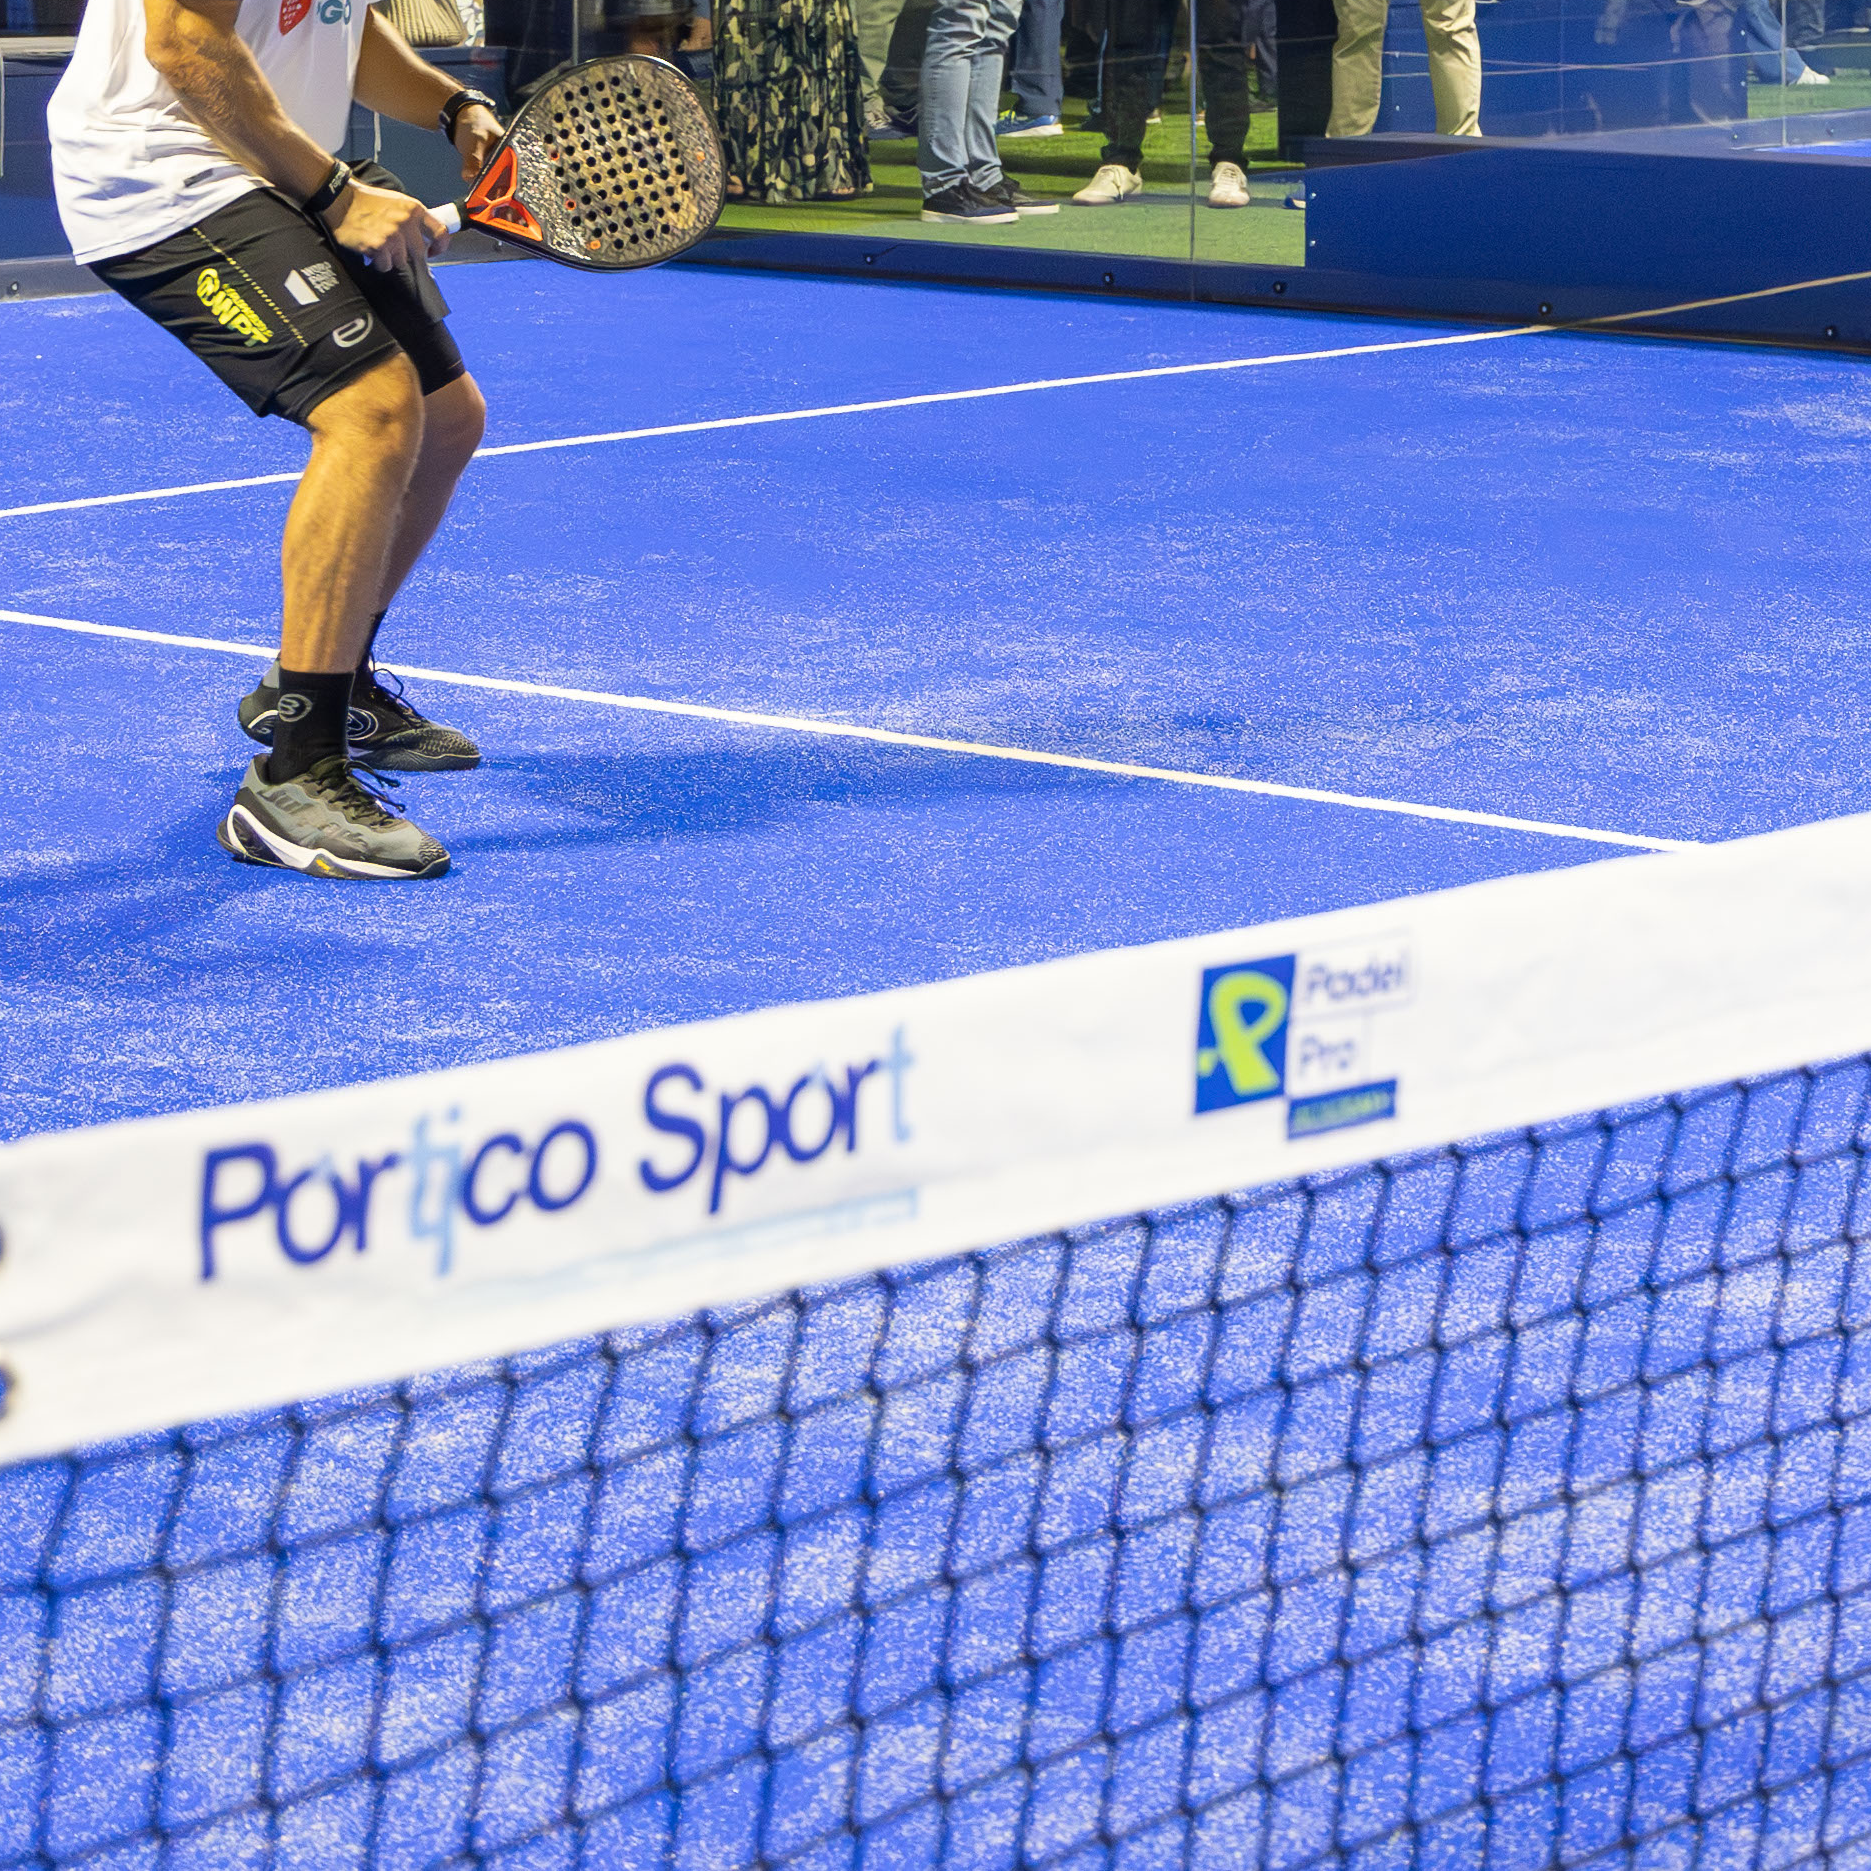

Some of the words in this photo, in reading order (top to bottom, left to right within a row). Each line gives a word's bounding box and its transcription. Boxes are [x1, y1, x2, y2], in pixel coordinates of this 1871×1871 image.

[211, 290, 269, 347] WPT
[1304, 945, 1406, 1004] Padel
[1299, 1031, 1358, 1079] Pro
[200, 1105, 597, 1281] Portico
[637, 1023, 917, 1216] Sport
